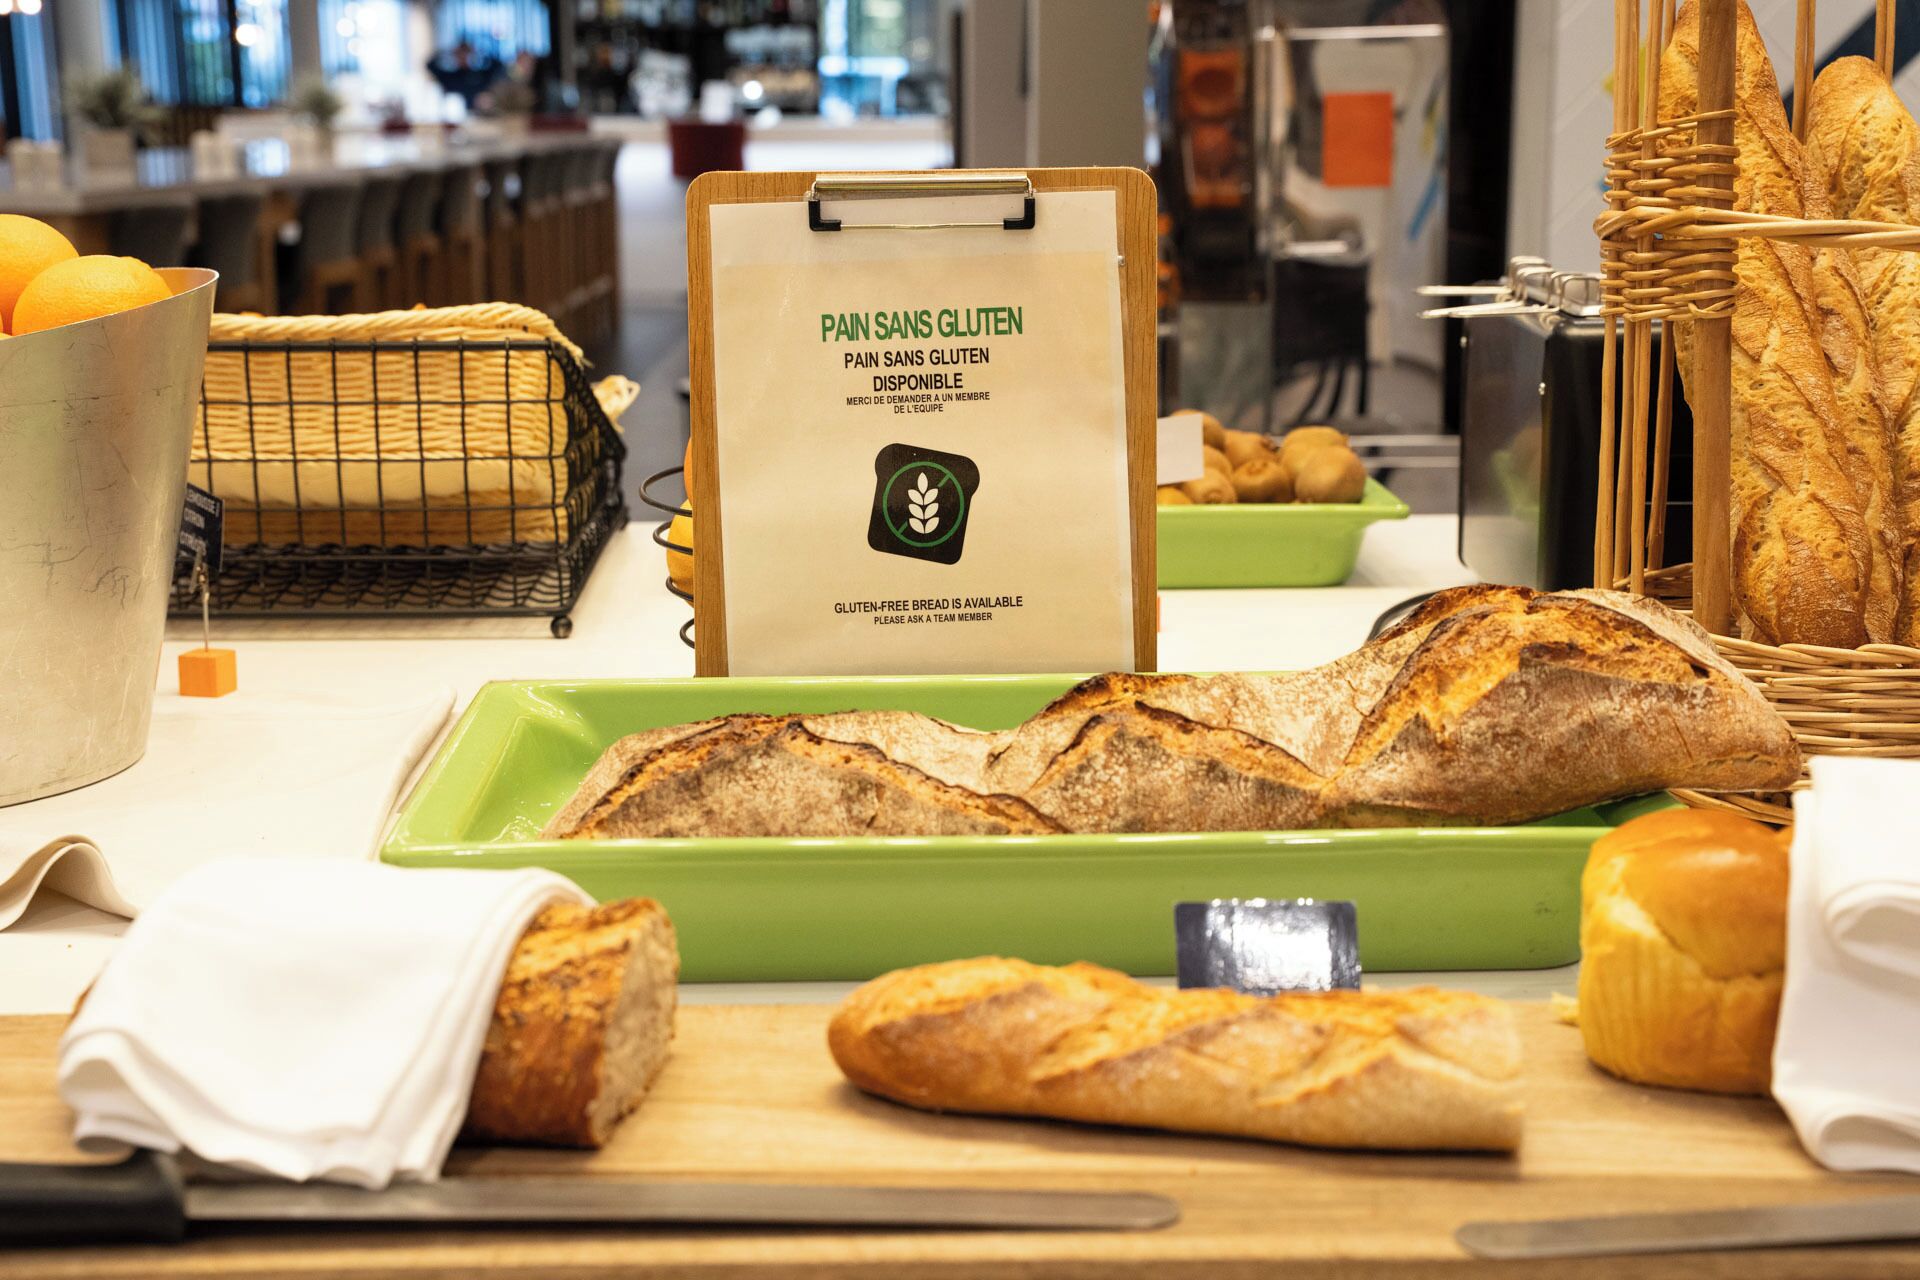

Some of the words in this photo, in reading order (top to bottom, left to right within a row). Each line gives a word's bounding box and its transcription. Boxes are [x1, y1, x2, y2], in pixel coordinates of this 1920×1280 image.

[821, 313, 870, 342] PAIN
[874, 310, 933, 340] SANS
[937, 307, 1023, 337] GLUTEN
[845, 352, 879, 368] PAIN
[883, 350, 924, 367] SANS
[929, 347, 989, 365] GLUTEN
[873, 373, 963, 392] DISPONIBLE
[846, 396, 871, 405] MERCI
[874, 396, 885, 405] DE
[886, 394, 932, 405] DEMANDER
[934, 394, 940, 402] A
[941, 394, 953, 402] UN
[955, 392, 990, 401] MEMBRE
[894, 405, 905, 413] DE
[907, 404, 943, 413] L'EQUIPE
[834, 600, 909, 613] GLUTEN-FREE
[912, 598, 949, 610] BREAD
[952, 598, 961, 609] IS
[964, 596, 1023, 608] AVAILABLE
[874, 615, 905, 624] PLEASE
[907, 614, 924, 623] ASK
[933, 614, 955, 622] TEAM
[958, 613, 992, 621] MEMBER
